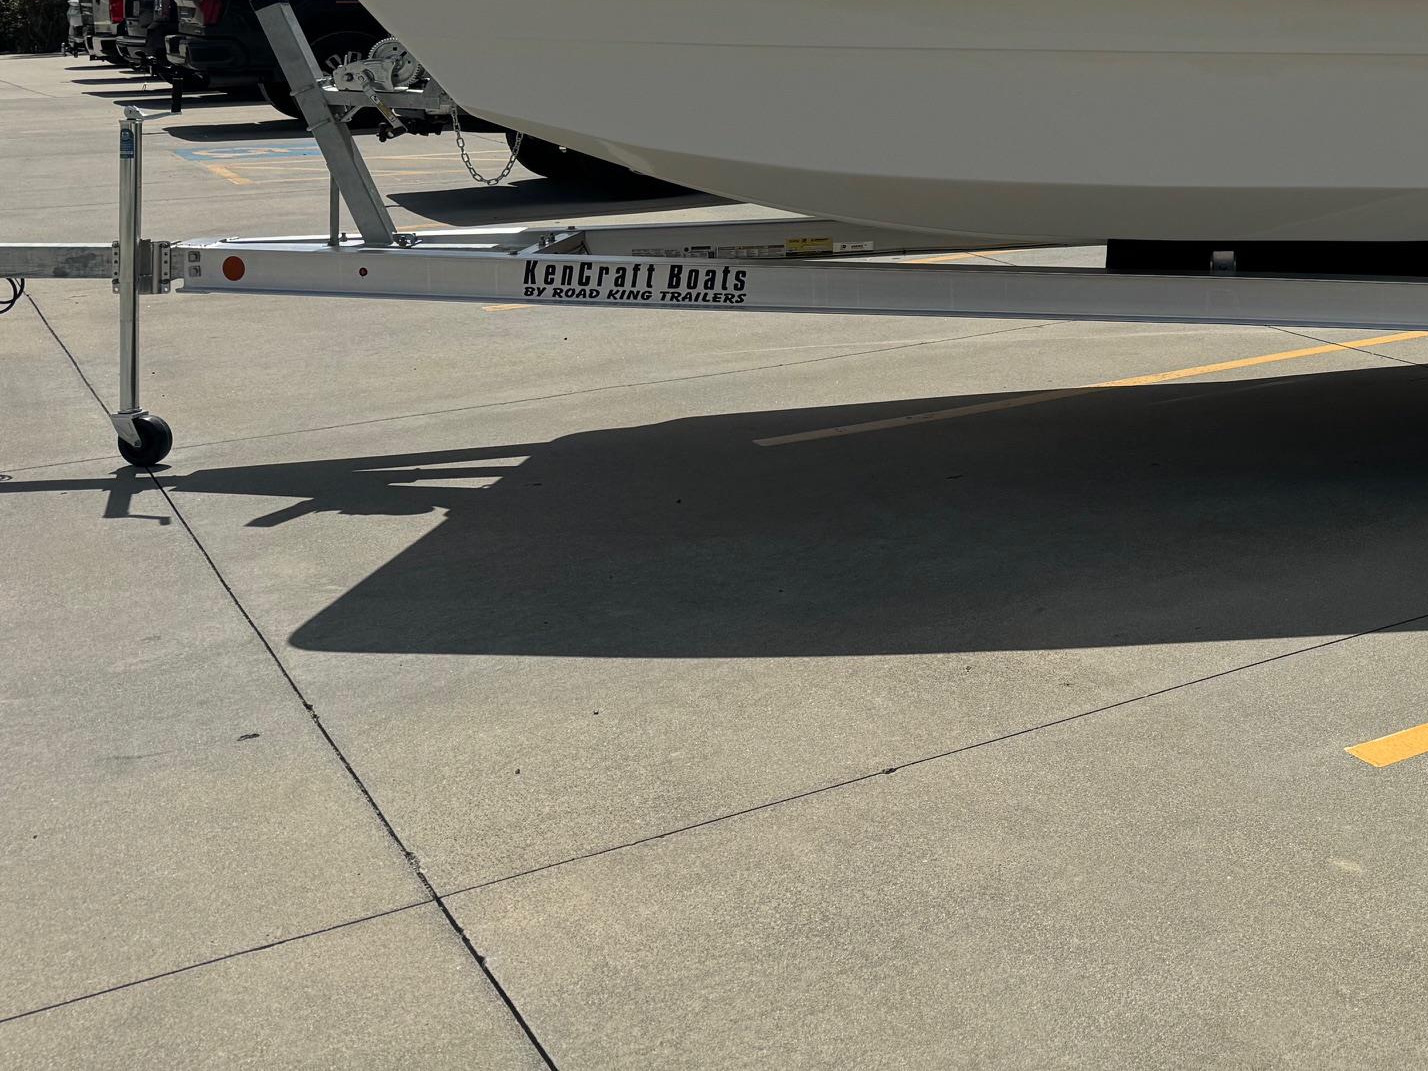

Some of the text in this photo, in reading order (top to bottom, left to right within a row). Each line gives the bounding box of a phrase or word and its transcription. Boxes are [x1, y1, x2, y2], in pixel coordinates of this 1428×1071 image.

[523, 259, 747, 292] KenCraft Boats
[523, 286, 747, 304] BY ROAD KING TRAILERS
